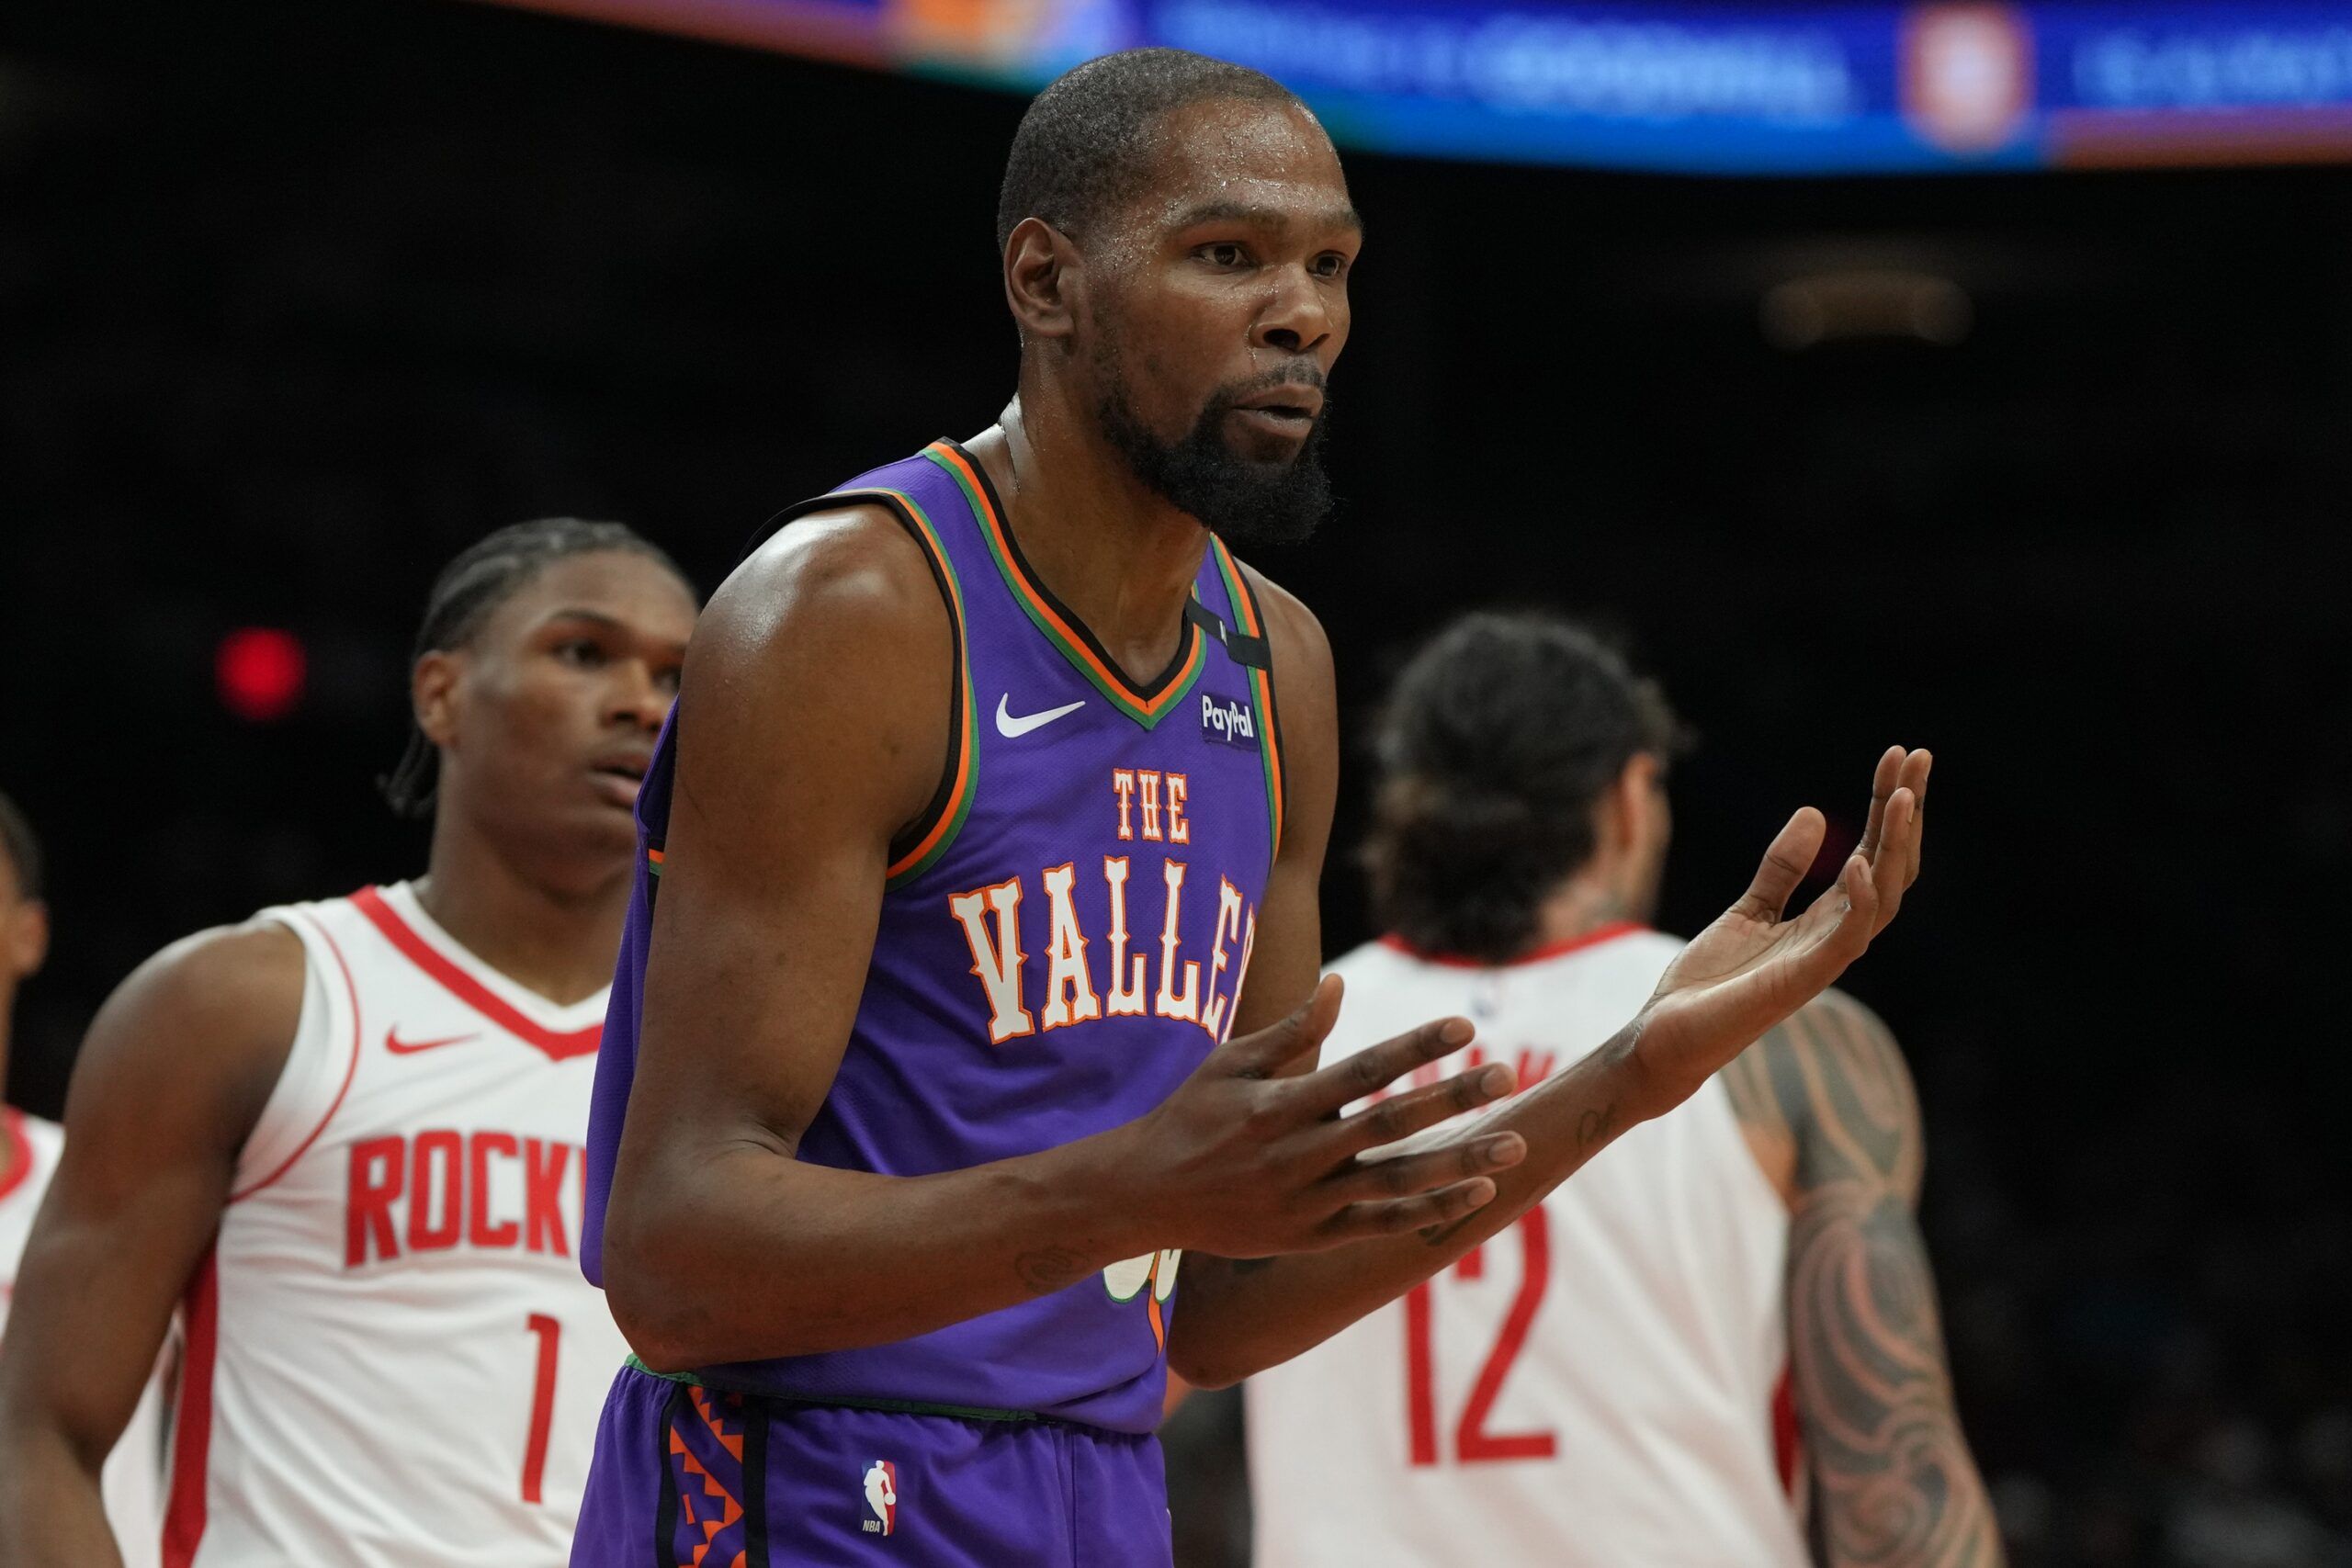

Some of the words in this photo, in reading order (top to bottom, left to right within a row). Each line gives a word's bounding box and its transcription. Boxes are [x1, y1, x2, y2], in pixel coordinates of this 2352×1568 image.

[1202, 694, 1253, 742] PayPal
[1114, 768, 1190, 844] THE
[345, 1129, 587, 1269] ROCK
[1404, 1201, 1557, 1467] 12
[521, 1313, 560, 1506] 1
[862, 1519, 881, 1533] NBA
